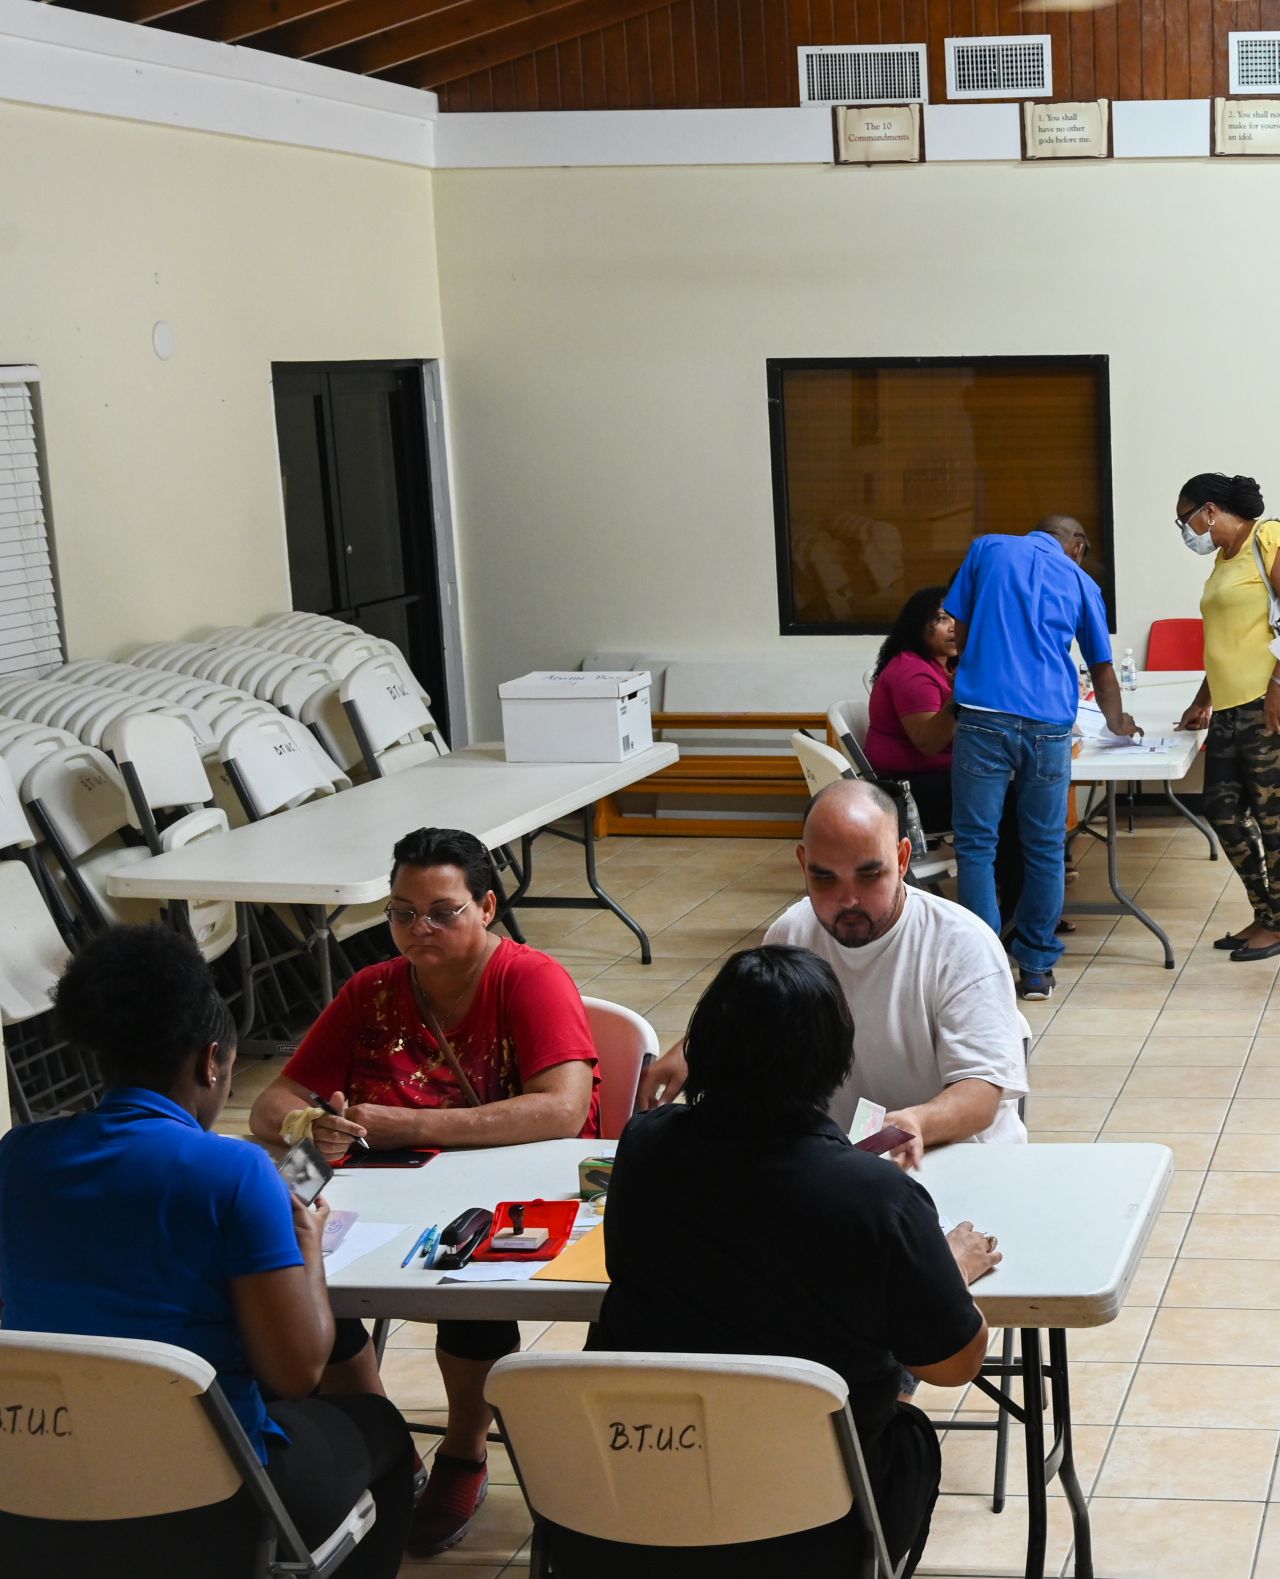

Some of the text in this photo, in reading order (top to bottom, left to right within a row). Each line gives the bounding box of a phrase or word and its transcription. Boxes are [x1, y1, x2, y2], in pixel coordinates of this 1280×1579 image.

[1062, 113, 1077, 121] shall
[1253, 110, 1268, 118] shall
[864, 122, 892, 131] The 10
[1038, 125, 1054, 133] have
[1067, 124, 1085, 132] other
[848, 133, 909, 142] Commandments
[1038, 136, 1054, 145] gods
[1056, 136, 1077, 144] before
[1239, 133, 1254, 141] idol.
[0, 1404, 72, 1437] .T.U.C.
[609, 1422, 702, 1452] B.T.U.C.
